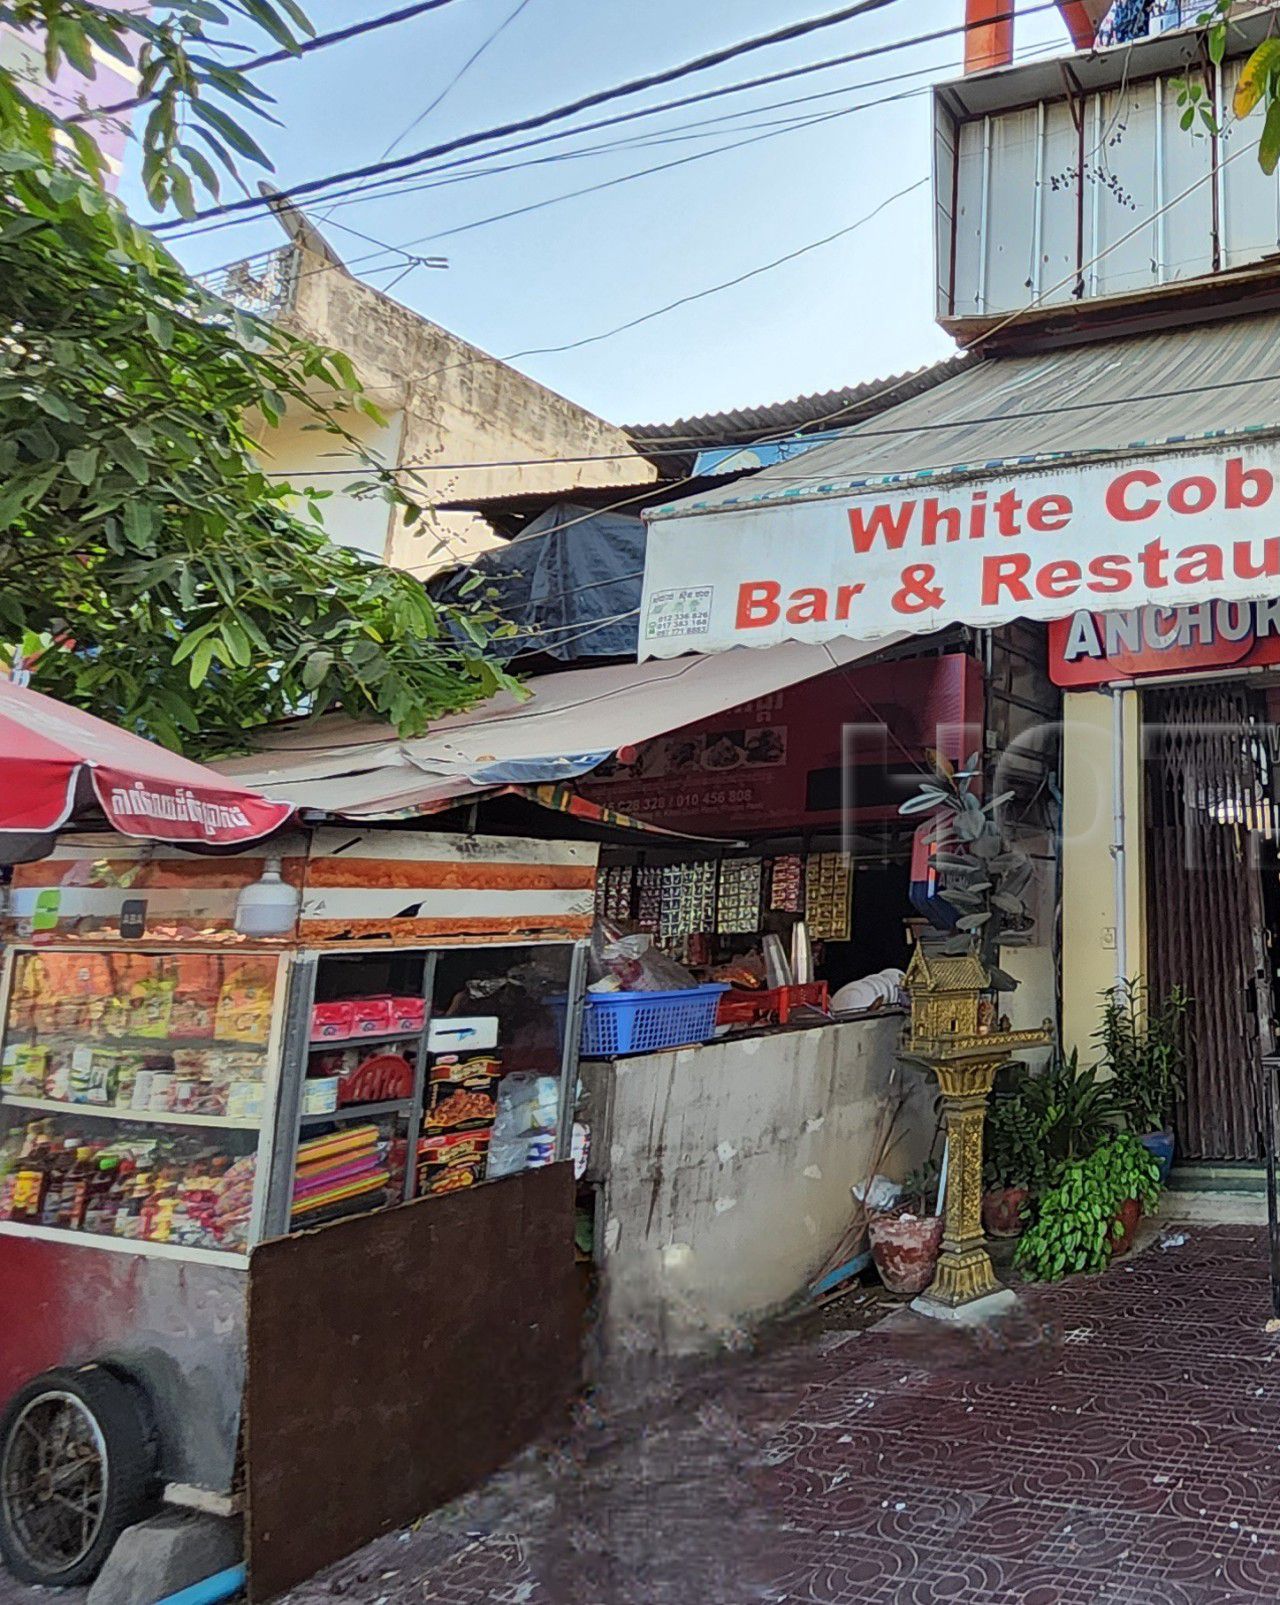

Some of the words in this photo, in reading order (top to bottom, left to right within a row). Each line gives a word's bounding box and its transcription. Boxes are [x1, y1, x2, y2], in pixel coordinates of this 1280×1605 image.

[848, 488, 1073, 554] White
[735, 580, 866, 630] Bar
[891, 563, 947, 614] &
